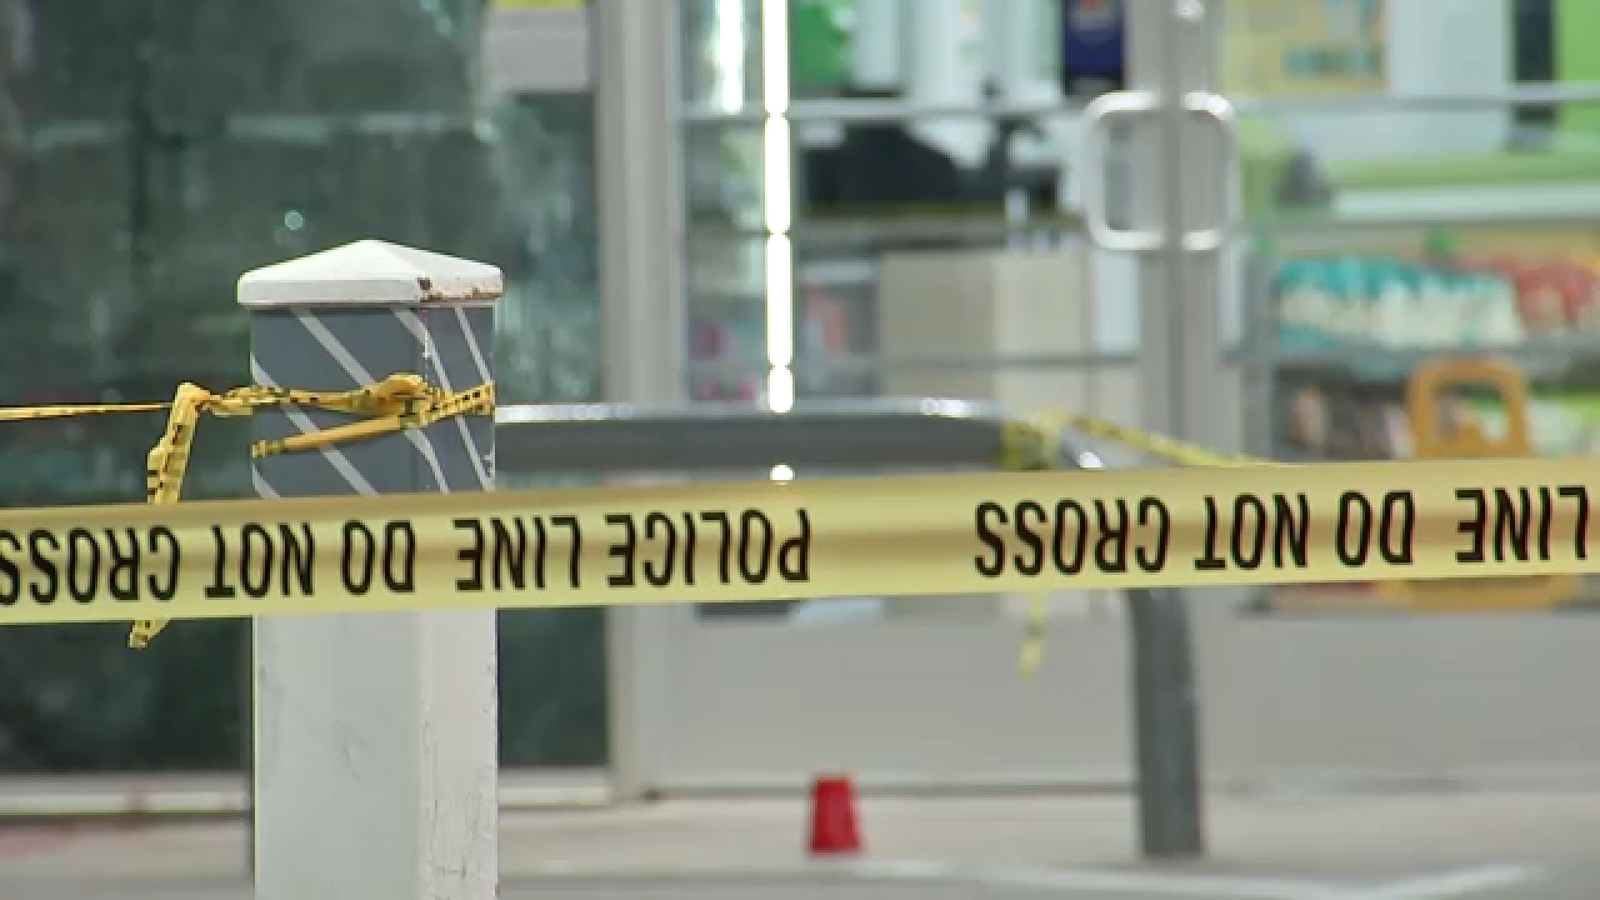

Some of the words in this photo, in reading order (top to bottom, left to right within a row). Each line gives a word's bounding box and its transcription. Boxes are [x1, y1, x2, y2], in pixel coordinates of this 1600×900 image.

[204, 521, 316, 599] NOT
[341, 519, 416, 596] DO
[454, 515, 581, 592] LINE
[604, 508, 811, 587] POLICE
[974, 497, 1171, 578] CROSS
[1194, 493, 1311, 571] NOT
[1334, 490, 1416, 567] DO
[1454, 485, 1589, 563] LINE
